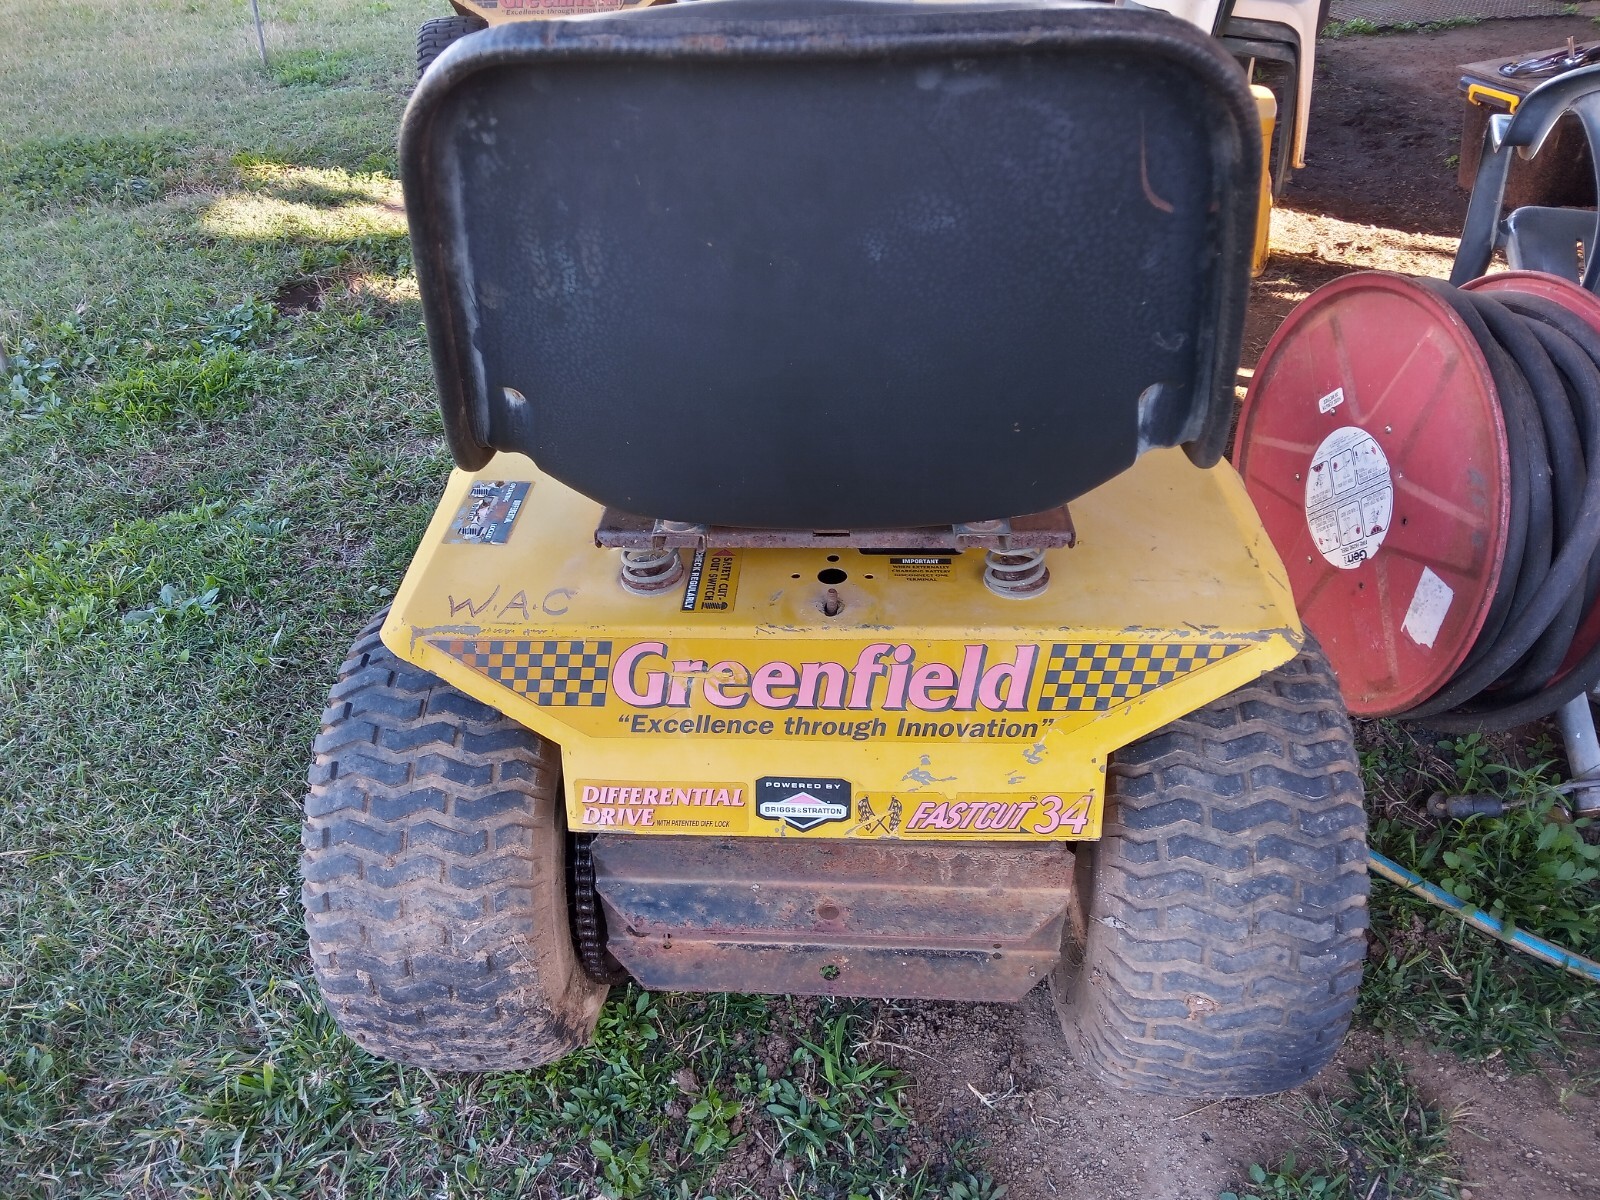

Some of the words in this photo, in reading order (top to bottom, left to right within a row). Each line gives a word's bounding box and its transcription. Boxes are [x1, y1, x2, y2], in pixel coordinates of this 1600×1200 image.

[709, 557, 721, 571] OUT
[720, 557, 733, 581] SAFETY
[684, 572, 700, 609] REGULARLY
[704, 573, 718, 601] SWITCH
[611, 641, 1040, 712] Greenfield
[784, 716, 887, 741] through
[581, 785, 746, 807] DIFFERENTIAL
[765, 781, 822, 789] POWERED
[582, 806, 655, 827] DRIVE
[656, 819, 670, 827] WITH
[714, 820, 730, 828] LOCK
[905, 801, 1038, 830] FASTCUT
[1033, 795, 1093, 834] 34
